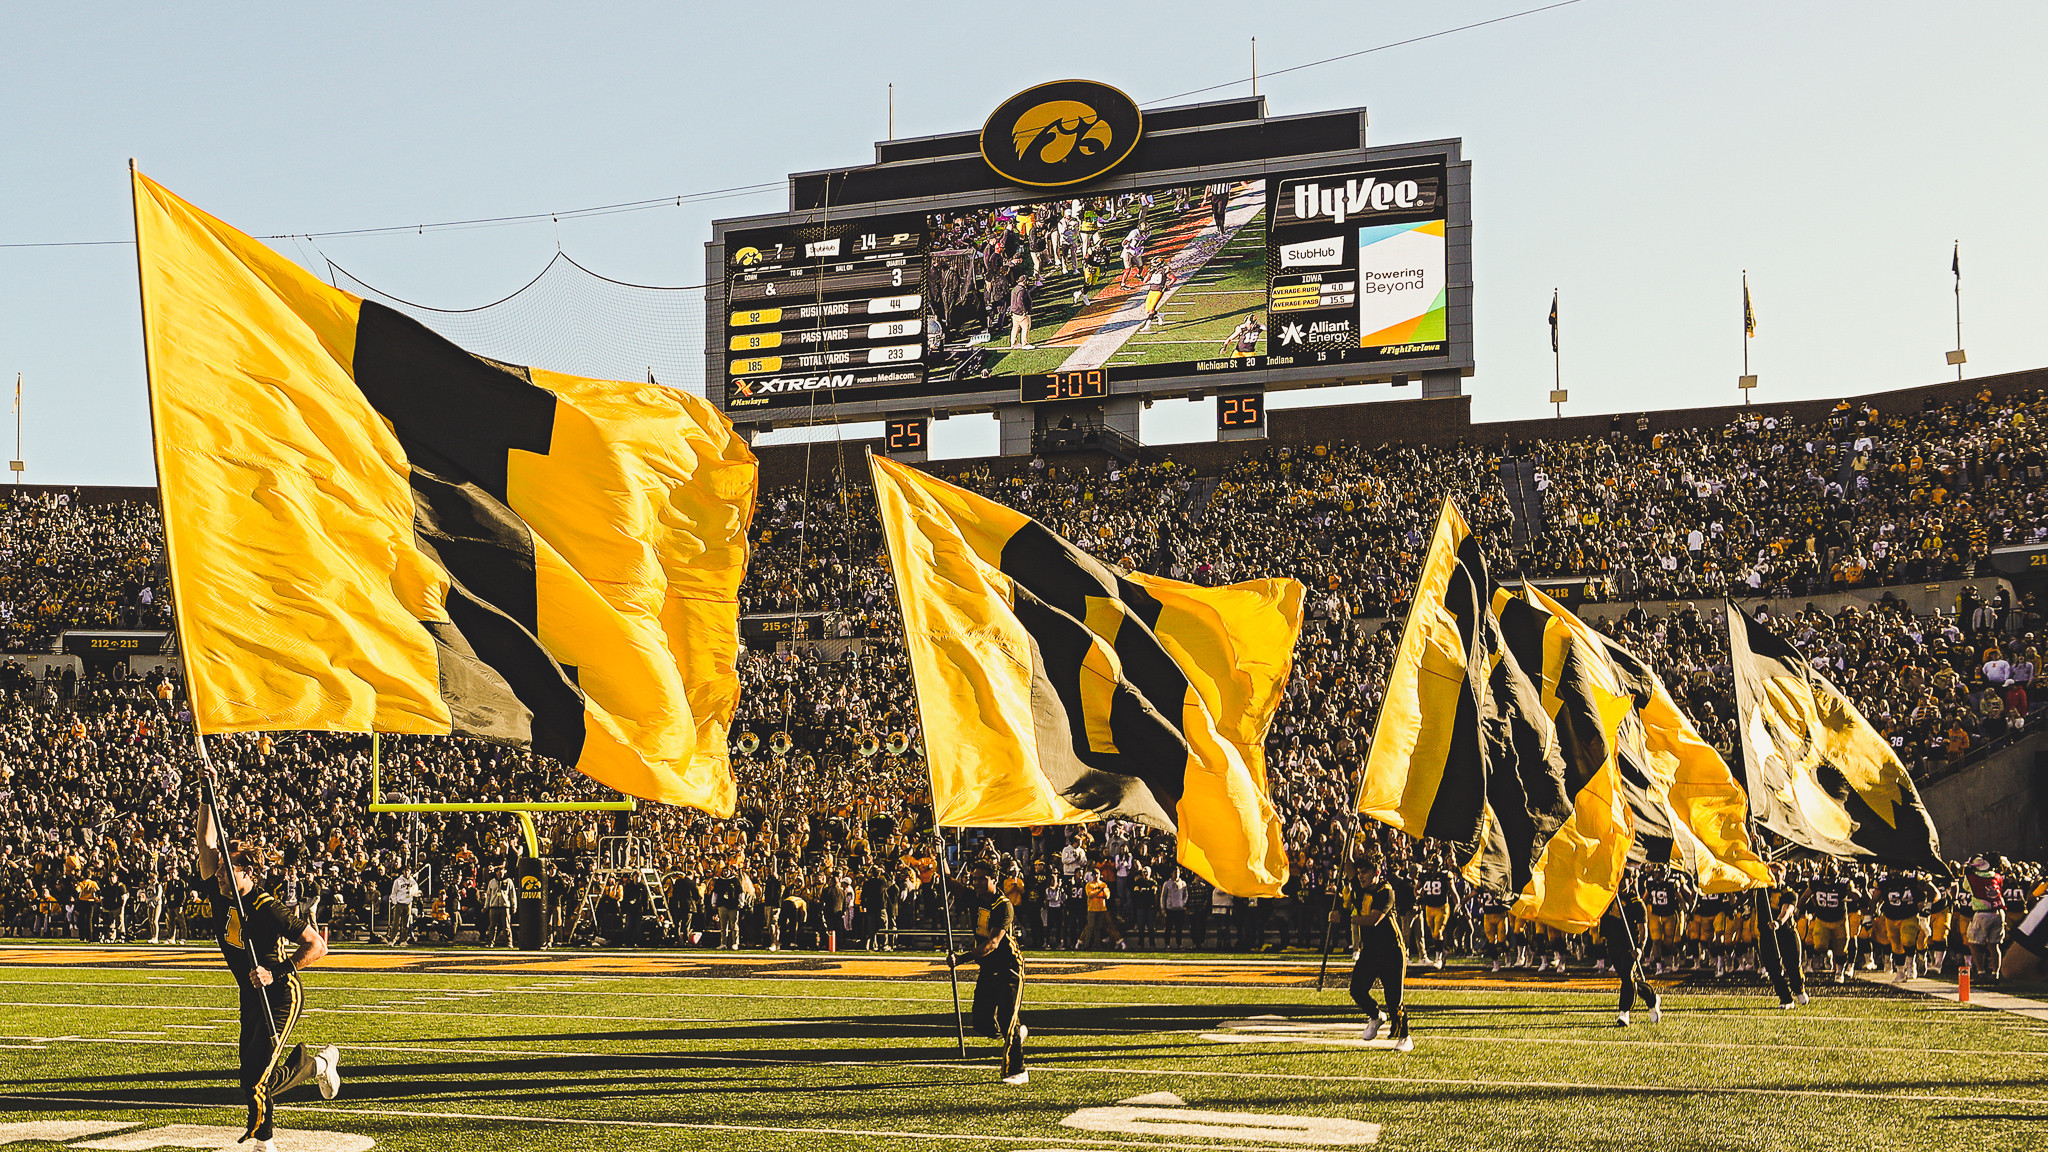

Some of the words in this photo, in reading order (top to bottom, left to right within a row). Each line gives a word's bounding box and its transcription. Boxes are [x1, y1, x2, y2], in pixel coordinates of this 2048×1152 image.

[861, 234, 876, 250] 14
[775, 244, 782, 259] 7
[1288, 247, 1335, 260] StubHub
[892, 268, 902, 287] 3
[1302, 274, 1322, 283] IOWA
[1366, 268, 1424, 281] Powering
[1366, 278, 1424, 294] Beyond
[750, 313, 760, 323] 92
[800, 306, 822, 318] RUSH
[822, 304, 849, 316] YARDS
[890, 299, 901, 309] 44
[1273, 300, 1301, 308] AVERAGE
[1308, 320, 1350, 333] Alliant
[750, 337, 760, 347] 93
[801, 331, 822, 343] PASS
[822, 328, 849, 341] YARDS
[888, 324, 904, 335] 189
[1380, 344, 1440, 355] #FightForIowa
[748, 361, 762, 371] 185
[799, 355, 822, 367] TOTAL
[822, 352, 850, 365] YARDS
[888, 349, 904, 360] 233
[1197, 359, 1229, 371] Michigan
[1229, 359, 1238, 368] St
[1246, 357, 1256, 367] 20
[1266, 355, 1294, 366] Indiana
[1317, 351, 1326, 361] 15
[757, 375, 855, 394] XTREAM
[1045, 371, 1102, 399] 3:09
[1224, 398, 1257, 425] 25
[890, 423, 921, 449] 25
[1546, 588, 1569, 599] 218
[762, 622, 781, 631] 215
[91, 639, 110, 648] 212
[120, 639, 139, 648] 213
[1890, 736, 1904, 747] 38
[521, 891, 542, 899] IOWA
[1423, 881, 1442, 895] 48
[1816, 891, 1839, 908] 65
